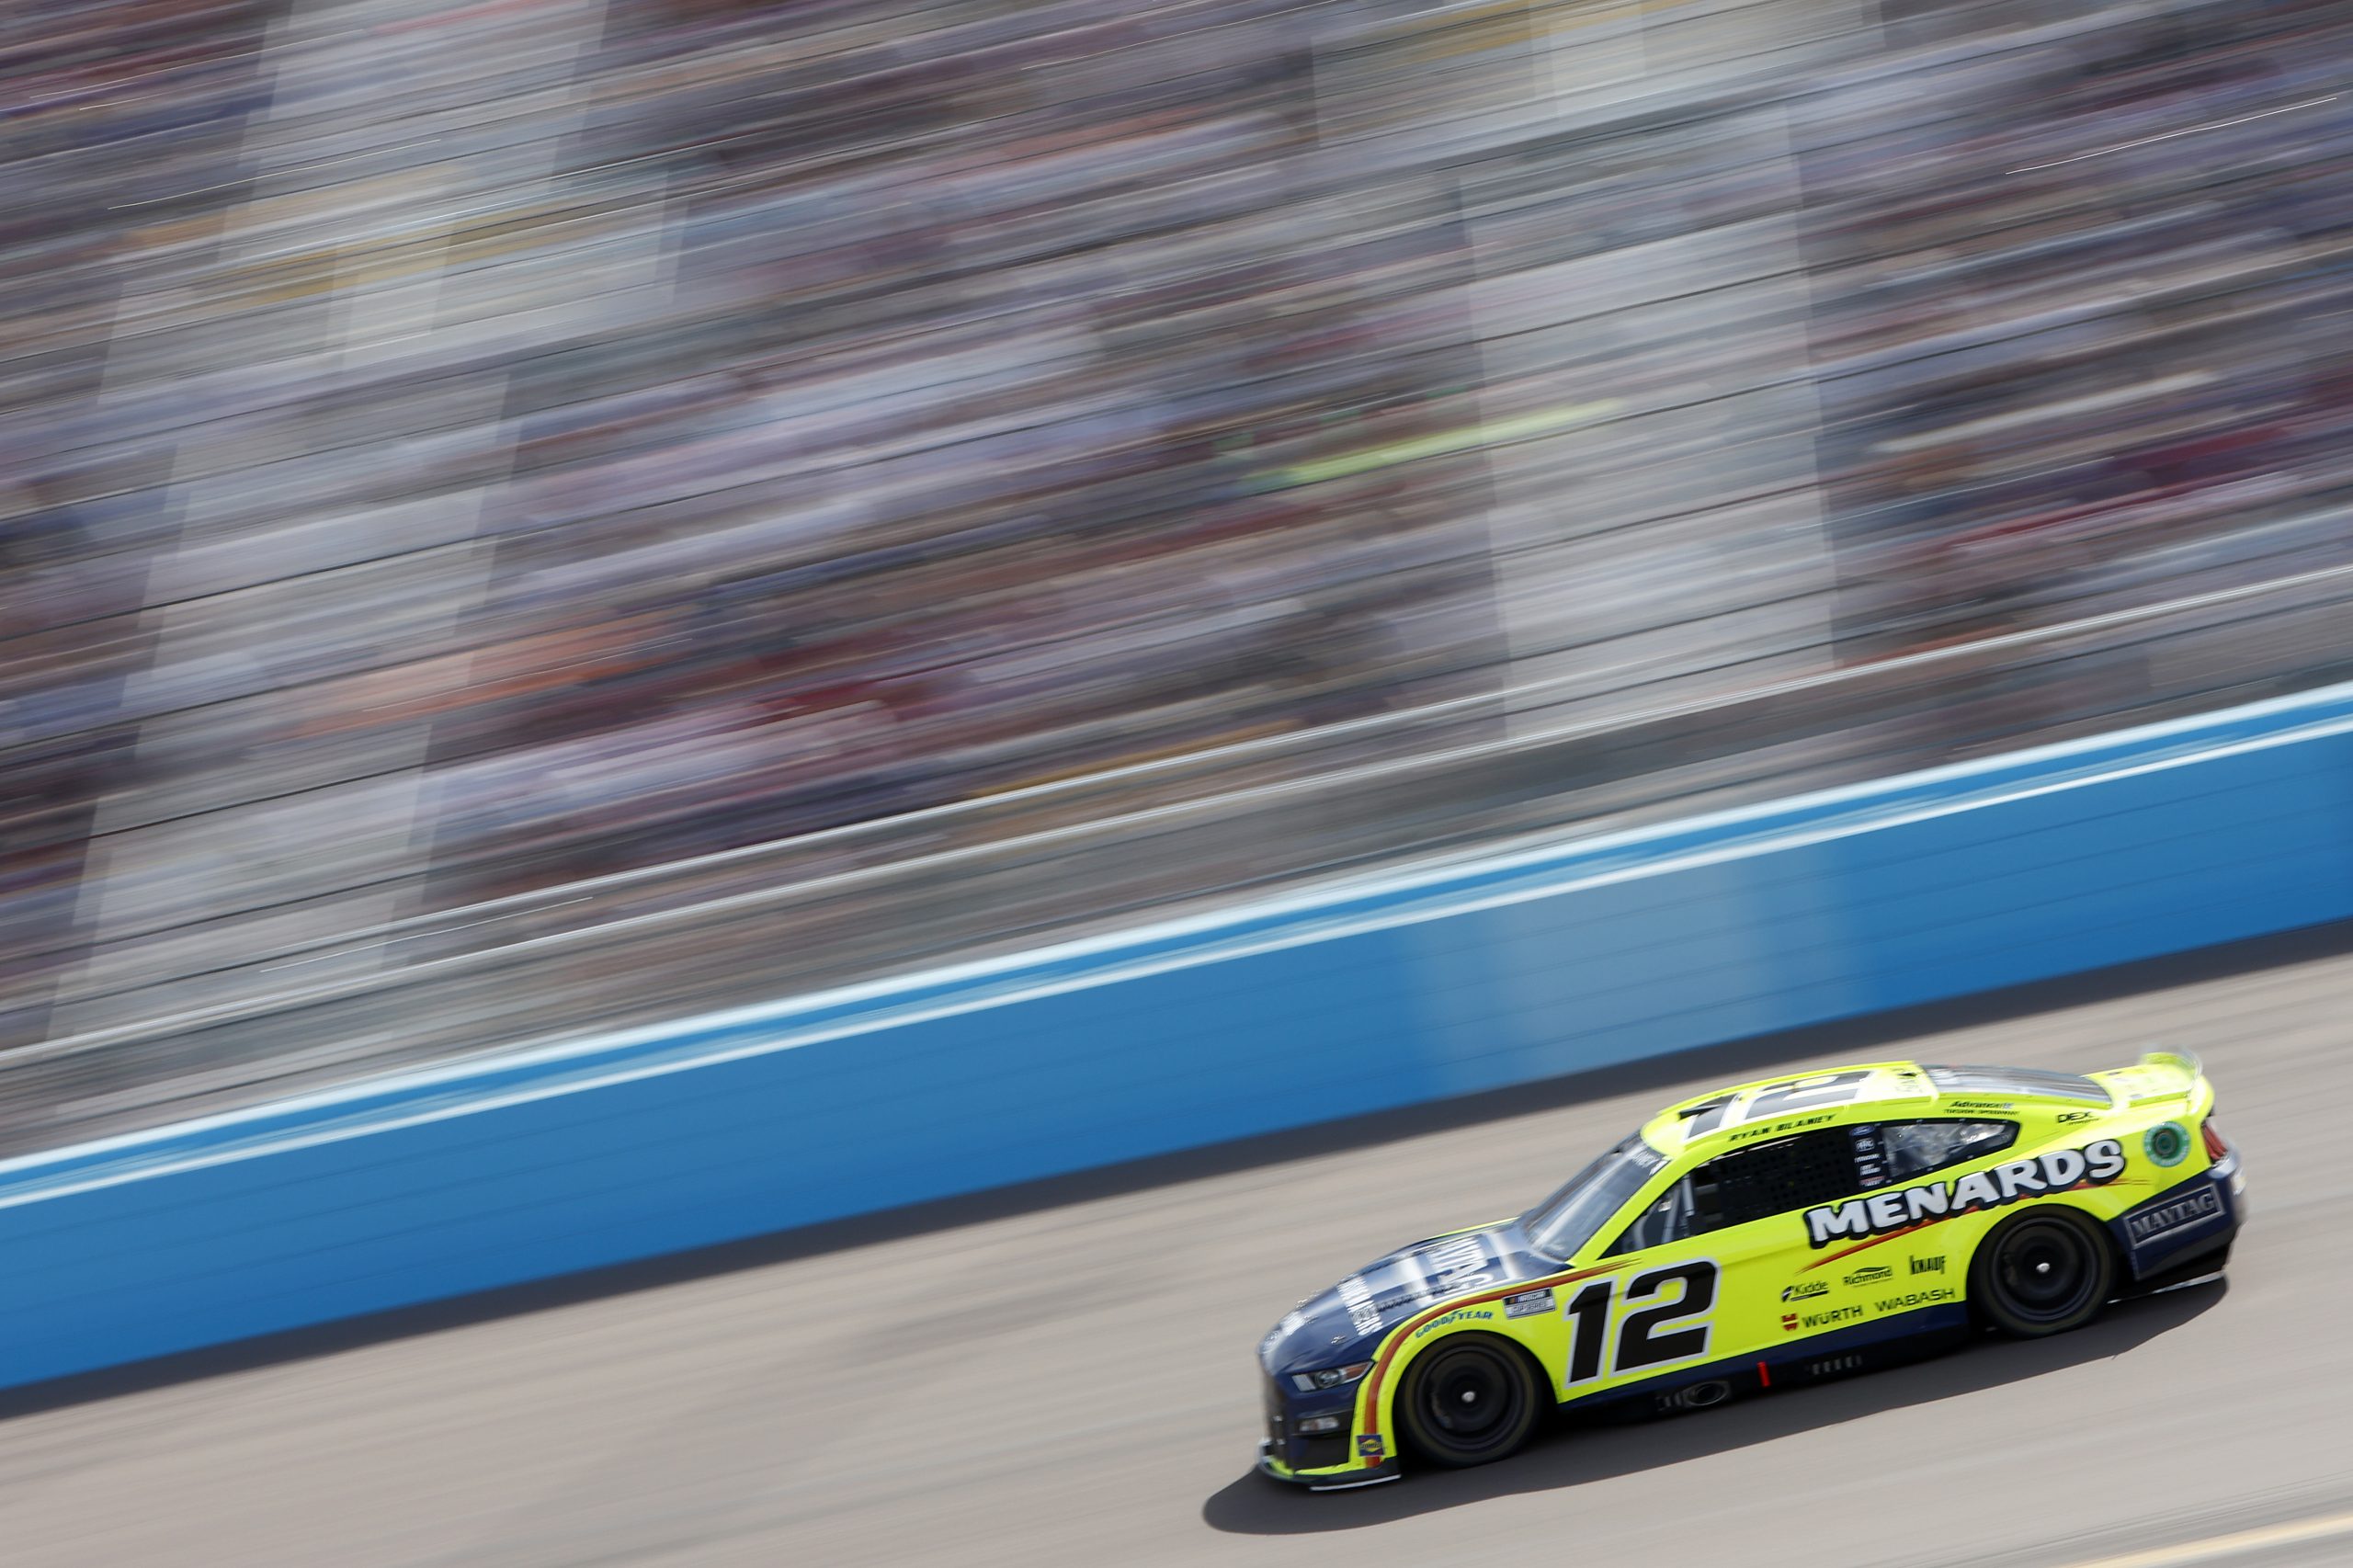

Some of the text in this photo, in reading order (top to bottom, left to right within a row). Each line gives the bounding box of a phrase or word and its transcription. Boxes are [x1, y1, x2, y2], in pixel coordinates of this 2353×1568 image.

[1729, 1126, 1771, 1142] RYAN
[1775, 1113, 1837, 1131] BLANEY
[2058, 1111, 2096, 1123] DEX
[1805, 1139, 2125, 1245] MENARDS
[2131, 1193, 2216, 1236] MAYTAG
[1794, 1280, 1829, 1294] Kidde
[1843, 1266, 1893, 1285] Richmond
[1802, 1288, 1956, 1328] WÜRTH WABASH
[1415, 1309, 1494, 1338] GOODYEAR
[1567, 1264, 1719, 1384] 12
